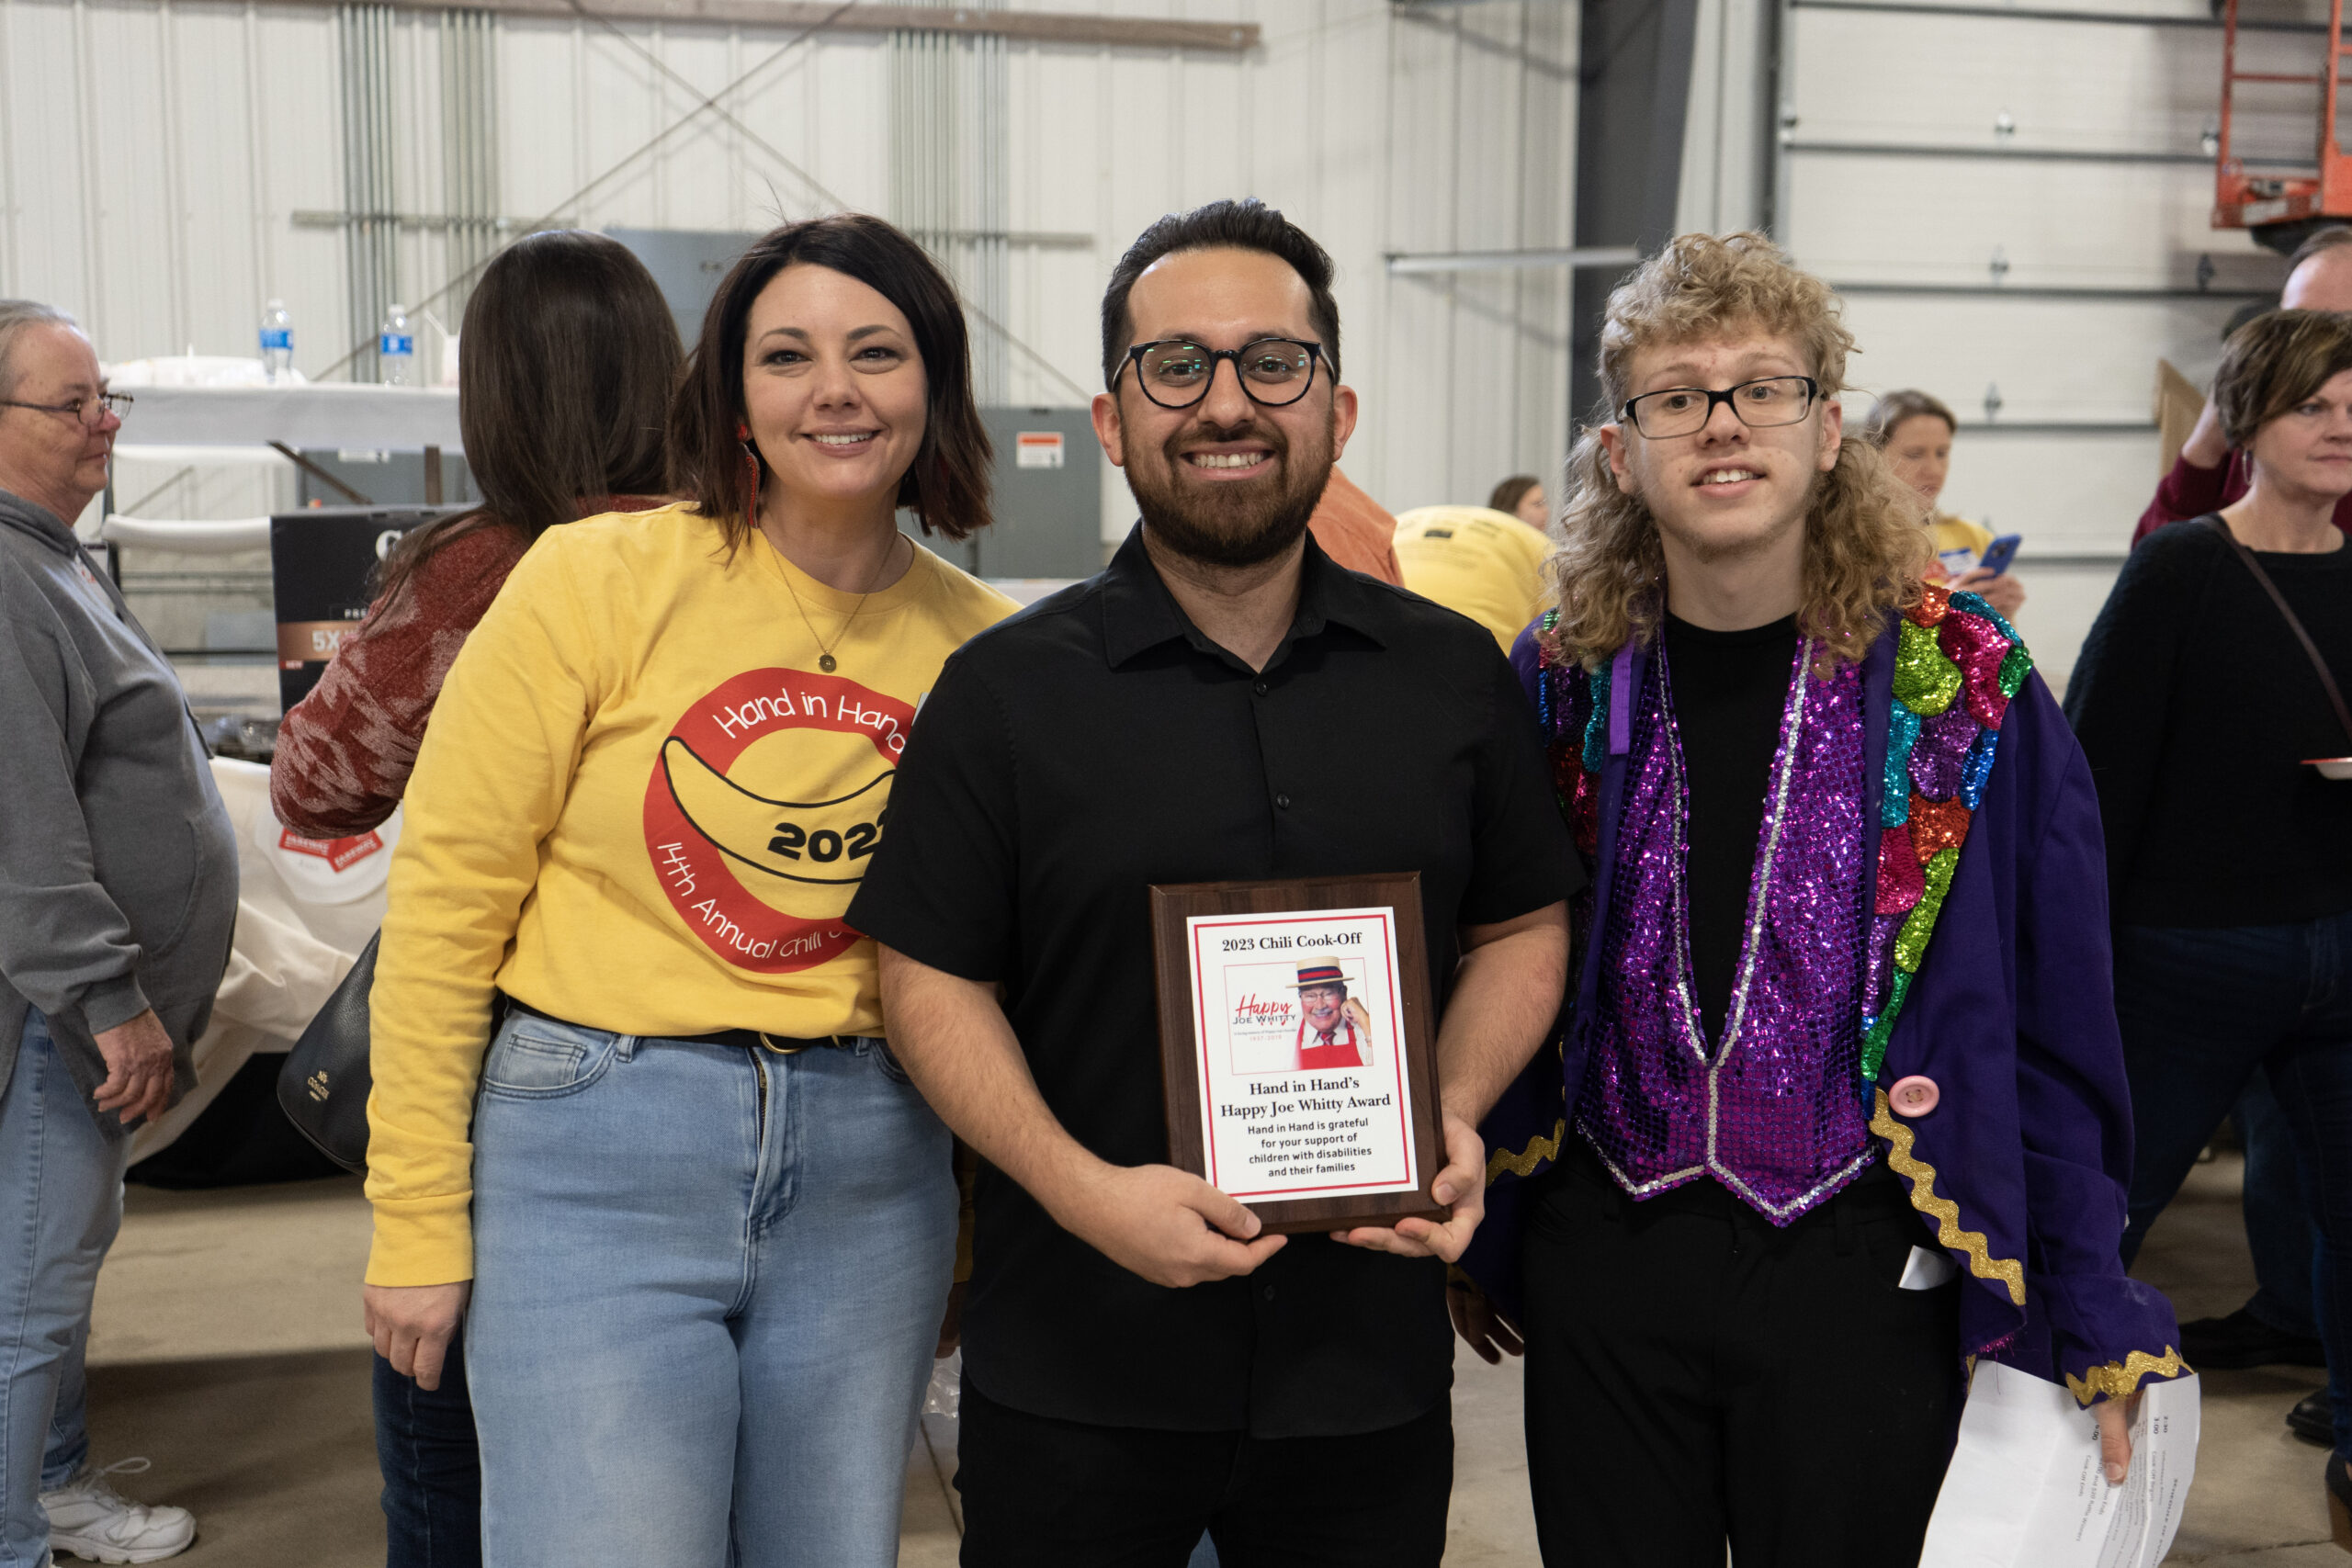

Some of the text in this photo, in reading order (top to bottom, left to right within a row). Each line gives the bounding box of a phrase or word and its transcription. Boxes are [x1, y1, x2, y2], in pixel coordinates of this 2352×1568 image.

[312, 630, 340, 652] 5X
[712, 687, 796, 739] Hand
[800, 692, 827, 718] in
[657, 842, 695, 897] 14th
[691, 898, 777, 959] Annual
[1222, 931, 1363, 952] 2023 Chili Cook-Off
[1235, 993, 1293, 1025] Happy
[1256, 1014, 1295, 1023] WHITTY
[1250, 1081, 1288, 1096] Hand
[1293, 1080, 1306, 1092] in
[1221, 1093, 1391, 1120] Happy Joe Whitty Award
[1248, 1118, 1369, 1134] Hand in Hand is grateful
[1261, 1133, 1358, 1149] for your support of
[1249, 1147, 1373, 1164] children with disabilities
[1268, 1163, 1356, 1177] and their families
